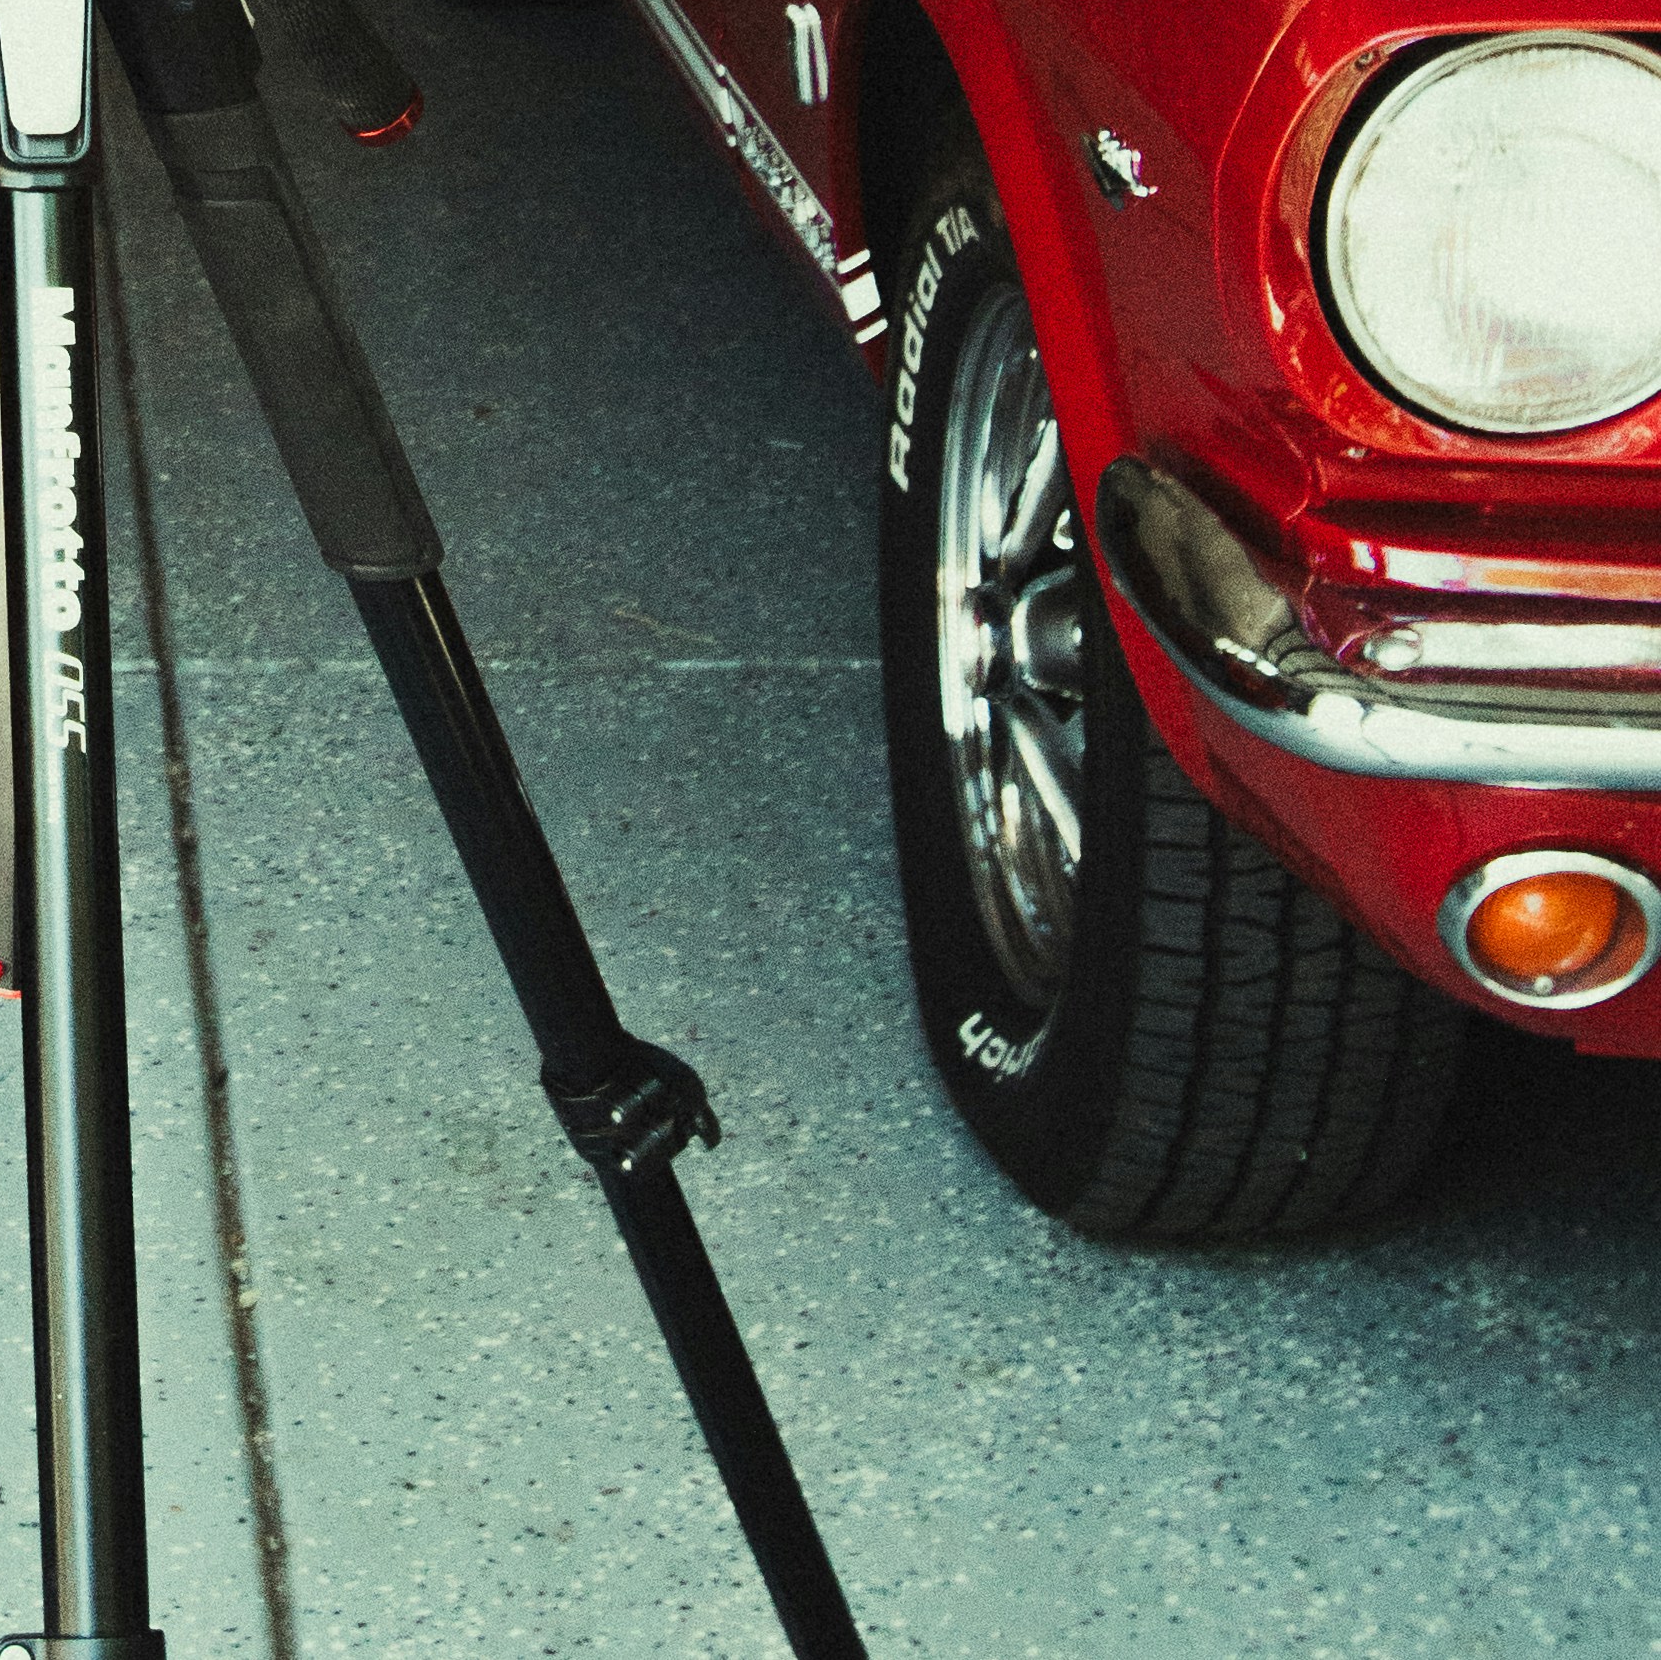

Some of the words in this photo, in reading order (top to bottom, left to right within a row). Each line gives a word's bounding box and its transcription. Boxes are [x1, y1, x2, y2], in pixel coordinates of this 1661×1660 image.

[29, 286, 86, 632] Manfrotto
[889, 241, 944, 493] Radial
[935, 206, 981, 257] T/A
